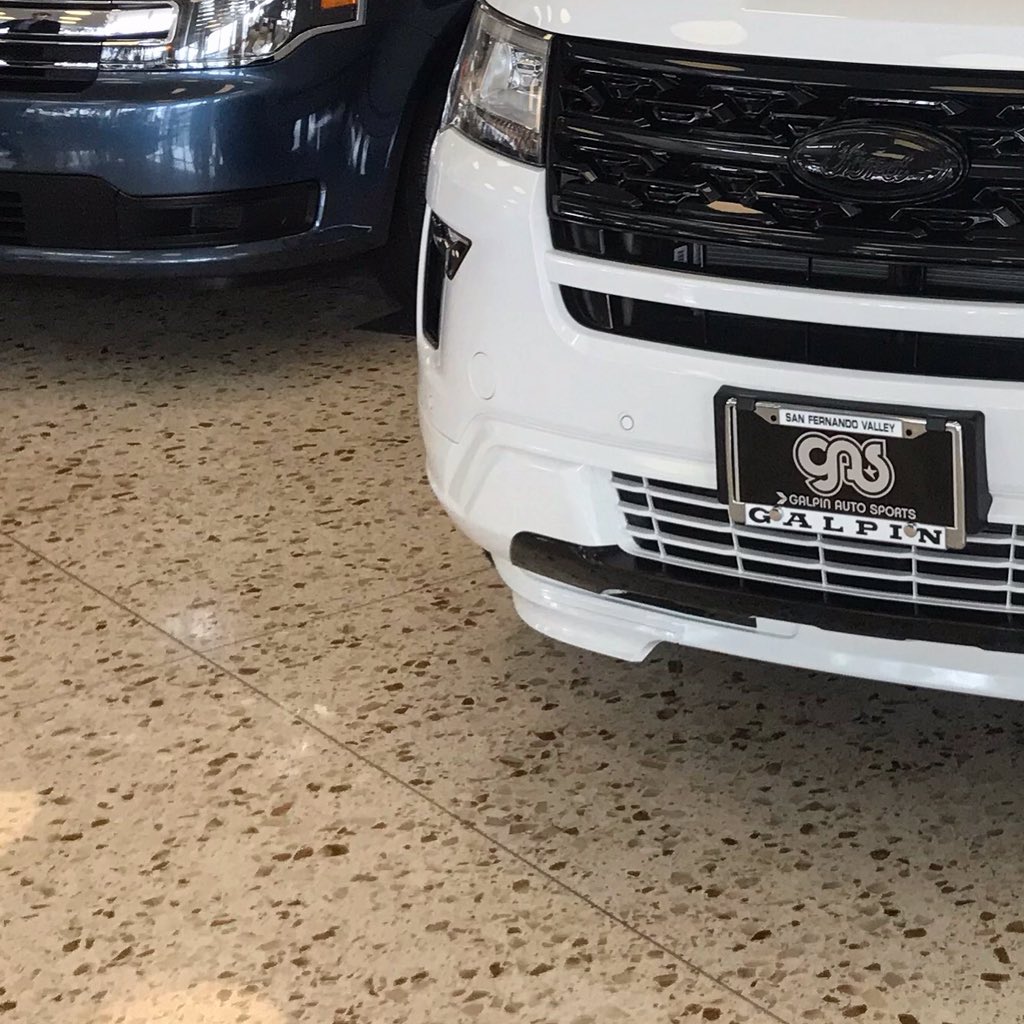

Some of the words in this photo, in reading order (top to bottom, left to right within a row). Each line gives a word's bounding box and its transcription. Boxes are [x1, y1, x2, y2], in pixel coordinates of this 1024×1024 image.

[786, 413, 804, 424] SAN
[808, 414, 859, 430] FERNANDO
[862, 420, 896, 433] VALLEY
[789, 494, 830, 509] GALPIN
[834, 499, 866, 514] AUTO
[870, 505, 916, 520] SPORTS
[749, 507, 942, 545] GALPIN
